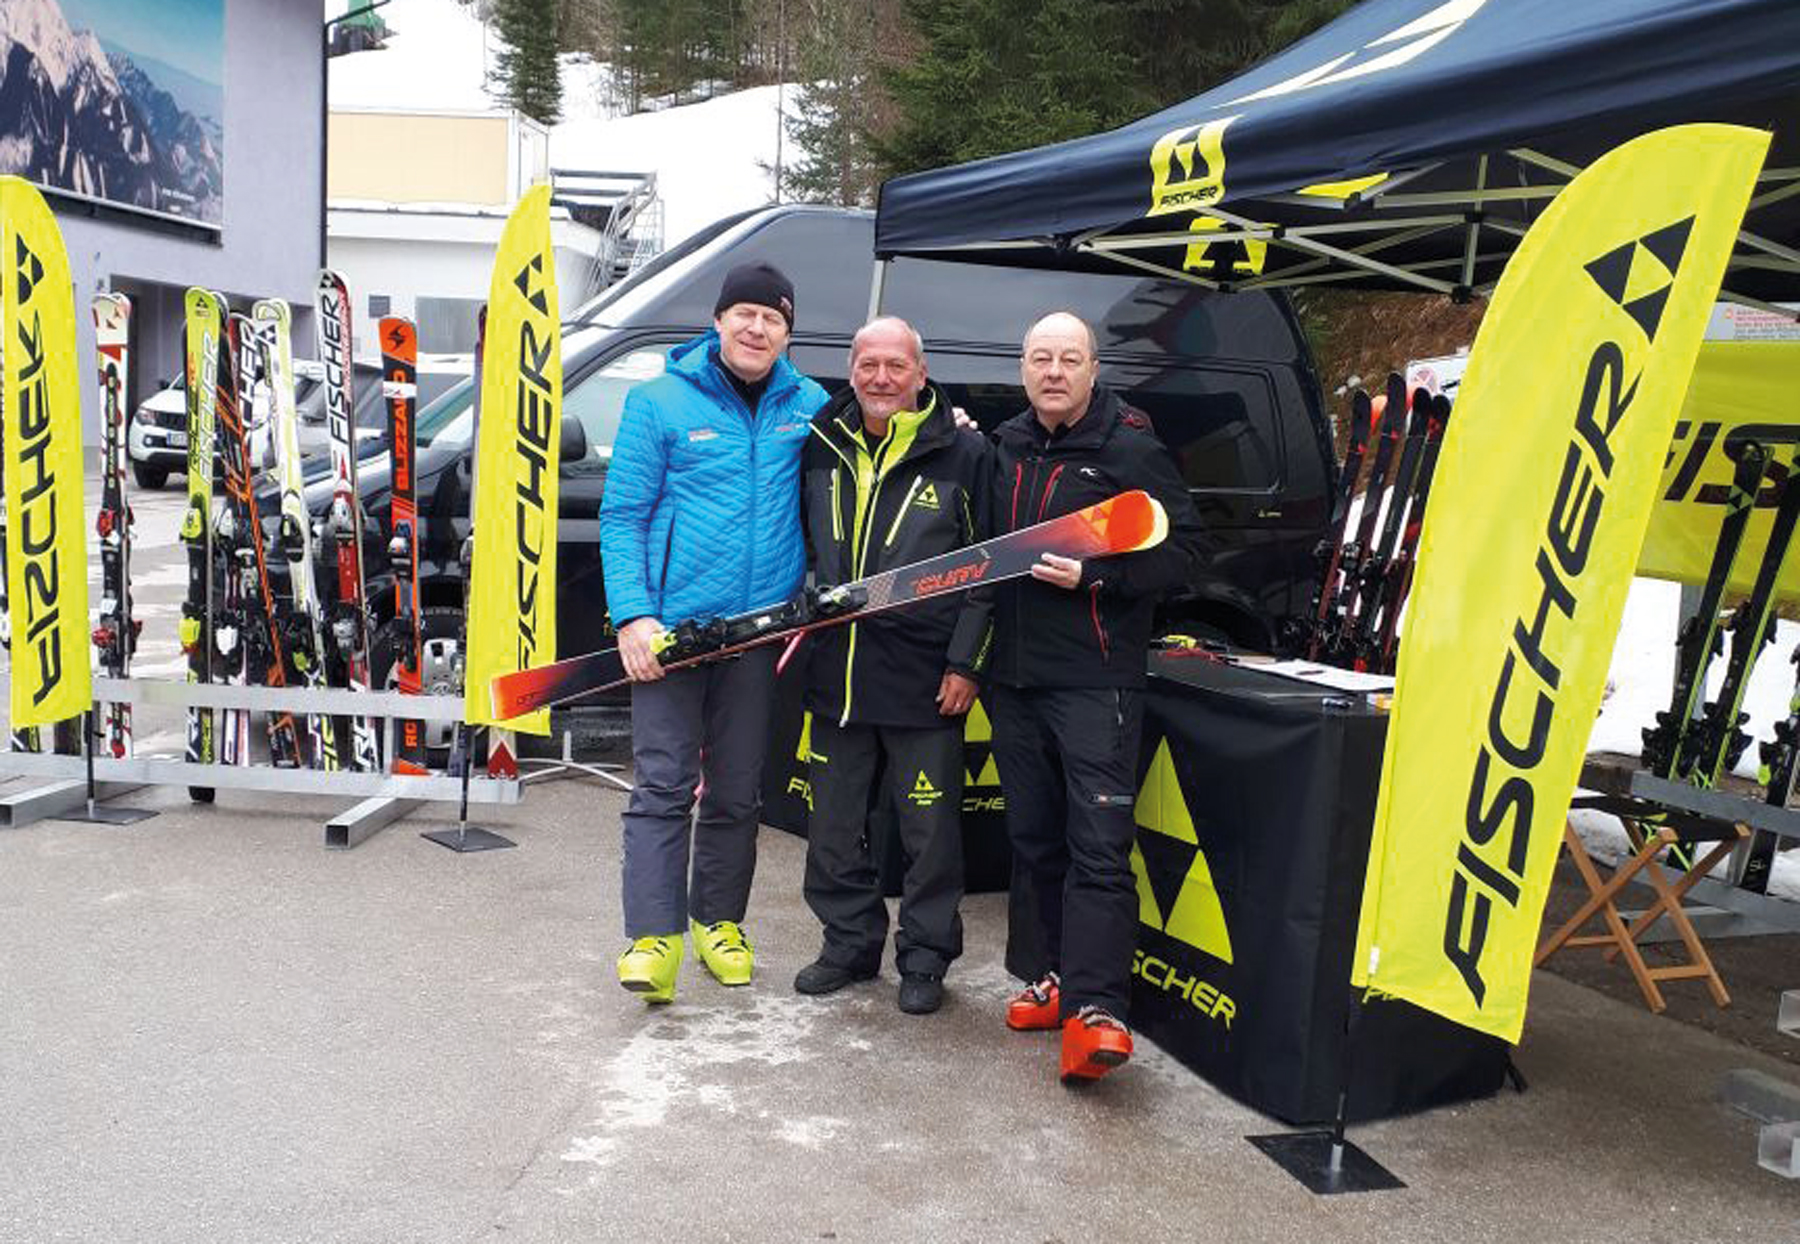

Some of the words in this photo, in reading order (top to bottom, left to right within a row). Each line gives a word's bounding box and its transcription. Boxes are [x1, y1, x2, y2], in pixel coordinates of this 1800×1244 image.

[1160, 185, 1219, 207] FISCHER
[199, 328, 218, 485] FISCHER
[321, 294, 347, 444] FISCHER
[1444, 341, 1645, 1011] FISCHER
